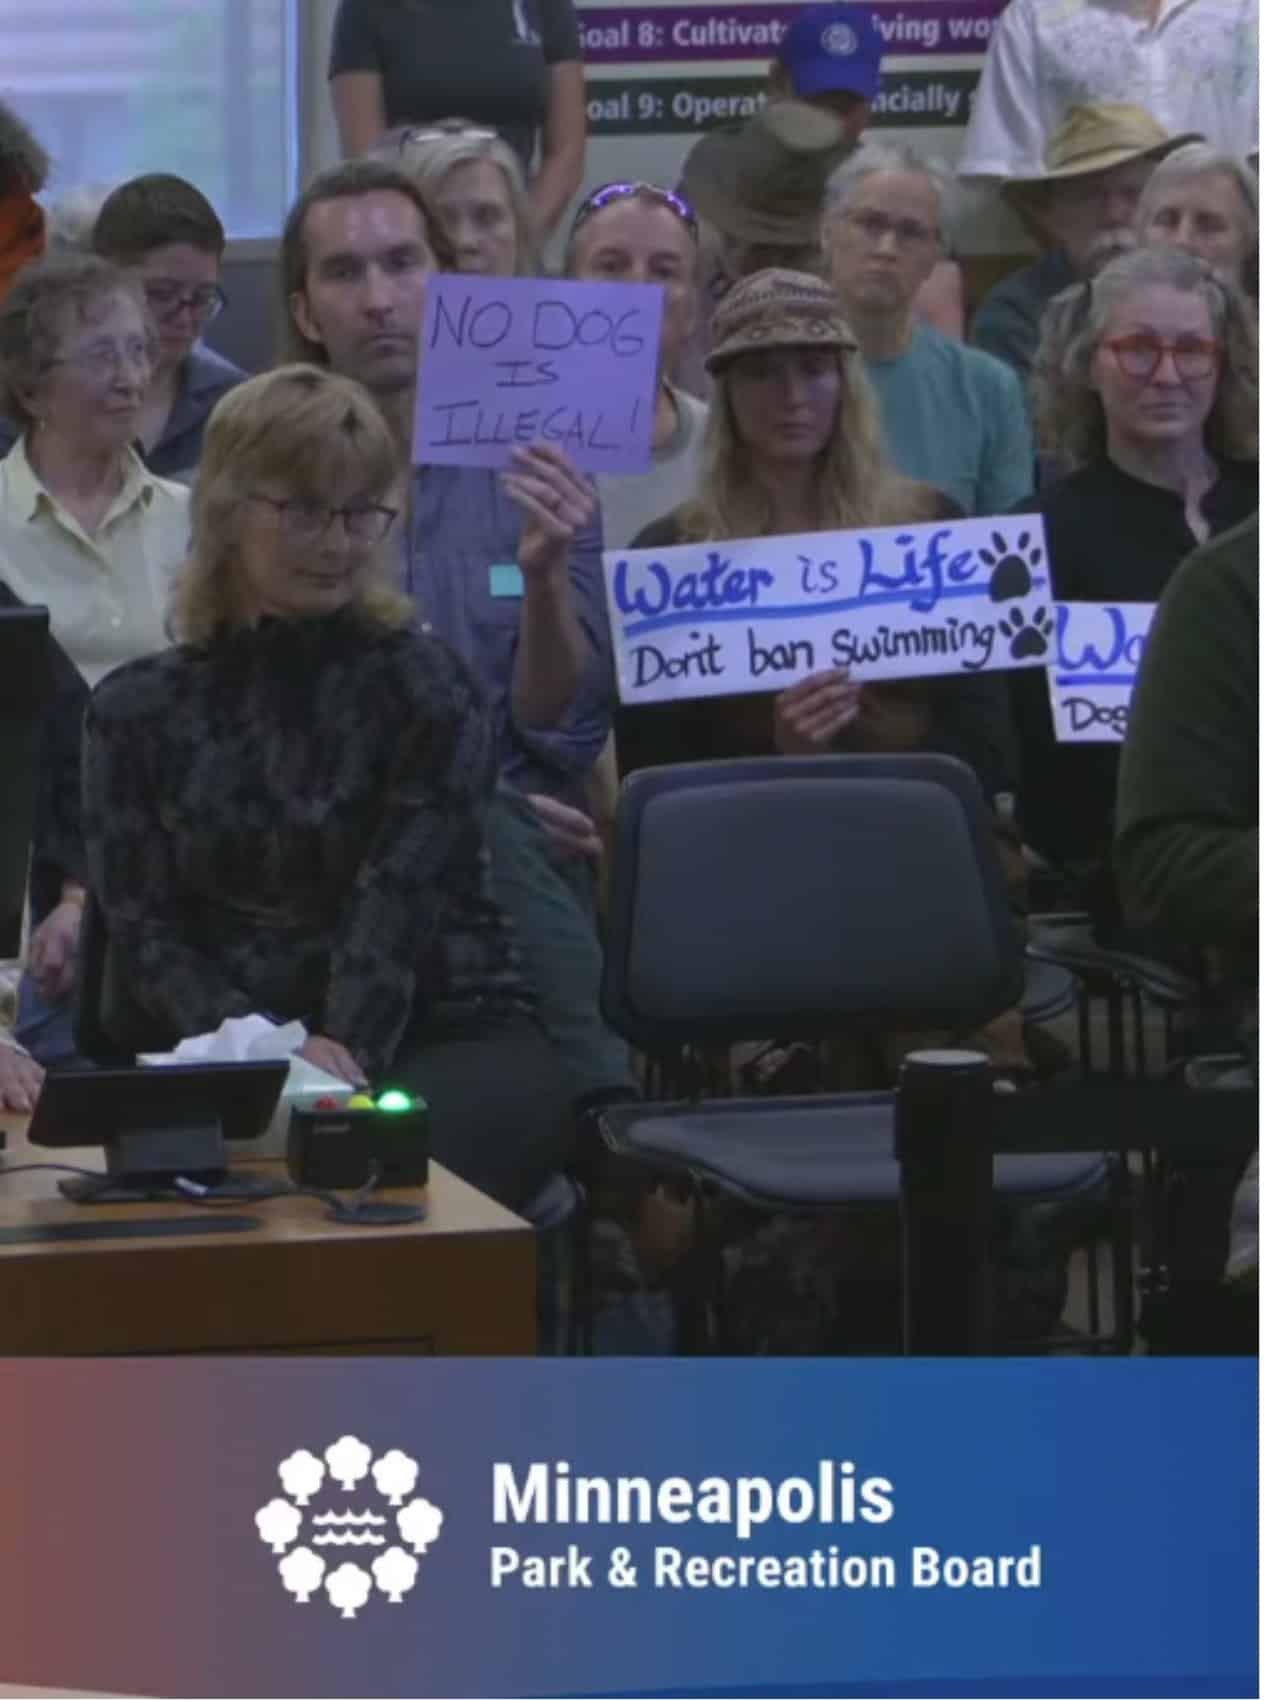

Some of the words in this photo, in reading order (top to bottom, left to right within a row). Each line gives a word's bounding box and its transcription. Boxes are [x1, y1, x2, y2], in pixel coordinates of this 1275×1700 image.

[579, 20, 629, 48] oal
[637, 20, 665, 48] 8:
[671, 17, 788, 48] Cultivat
[586, 90, 629, 120] oal
[637, 92, 664, 119] 9:
[672, 90, 768, 125] Operat
[431, 295, 512, 348] NO
[532, 300, 643, 356] DOG
[494, 359, 560, 388] IS
[613, 552, 774, 616] Water
[798, 554, 839, 593] is
[859, 529, 979, 612] Life
[631, 632, 726, 688] Don't
[747, 627, 814, 676] ban
